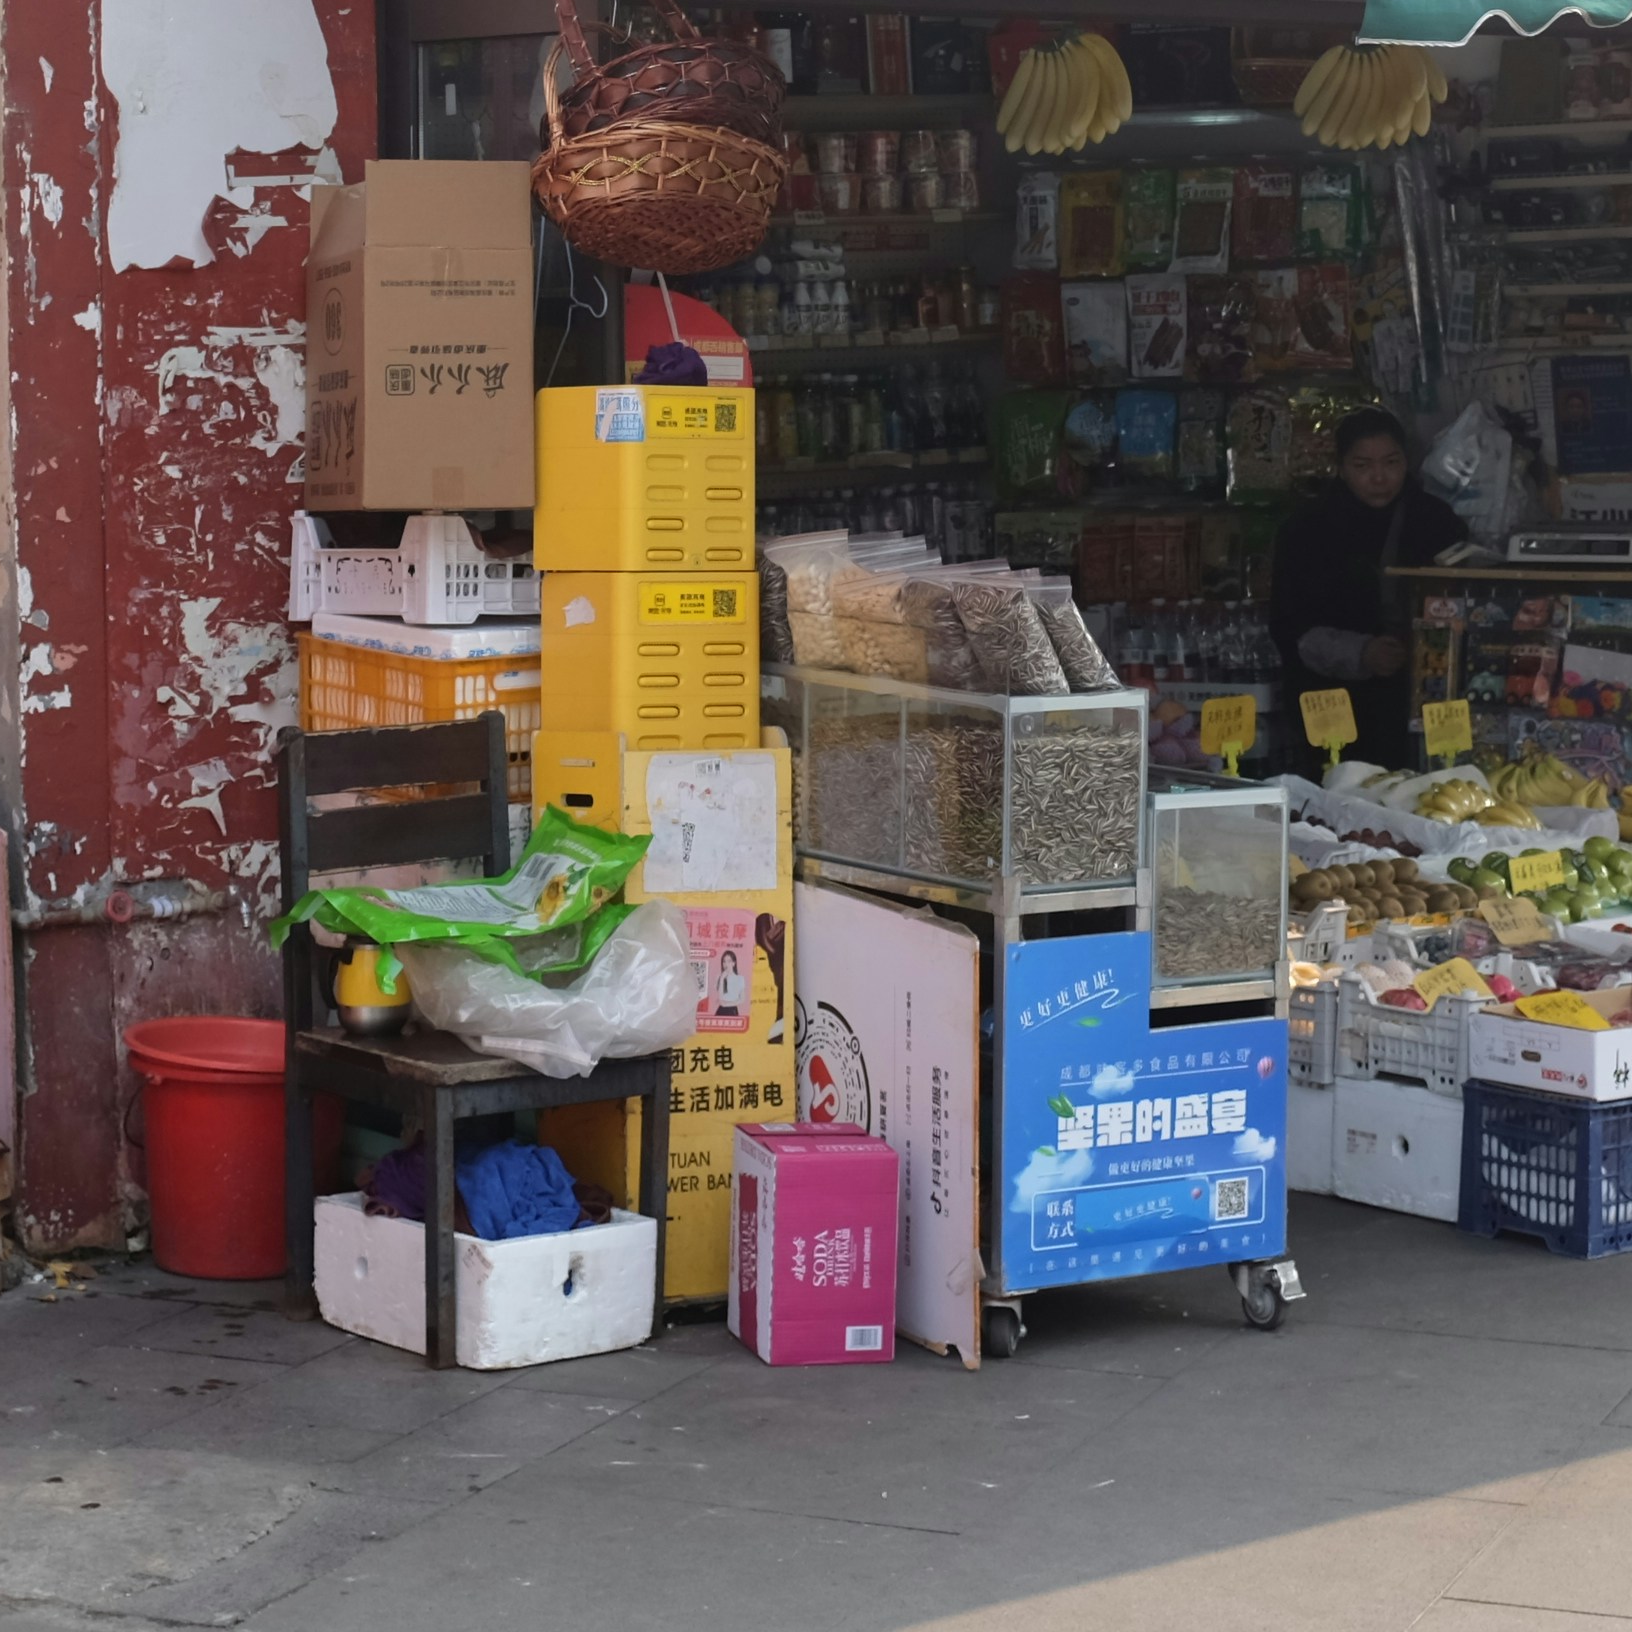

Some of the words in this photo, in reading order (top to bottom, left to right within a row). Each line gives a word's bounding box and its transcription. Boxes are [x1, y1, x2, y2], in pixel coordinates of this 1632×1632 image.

[931, 1065, 943, 1187] 抖音生活服务
[1056, 1088, 1248, 1152] 坚果的盛宴
[1046, 1198, 1075, 1216] 联系
[1047, 1220, 1075, 1240] 方式
[812, 1229, 829, 1287] SODA
